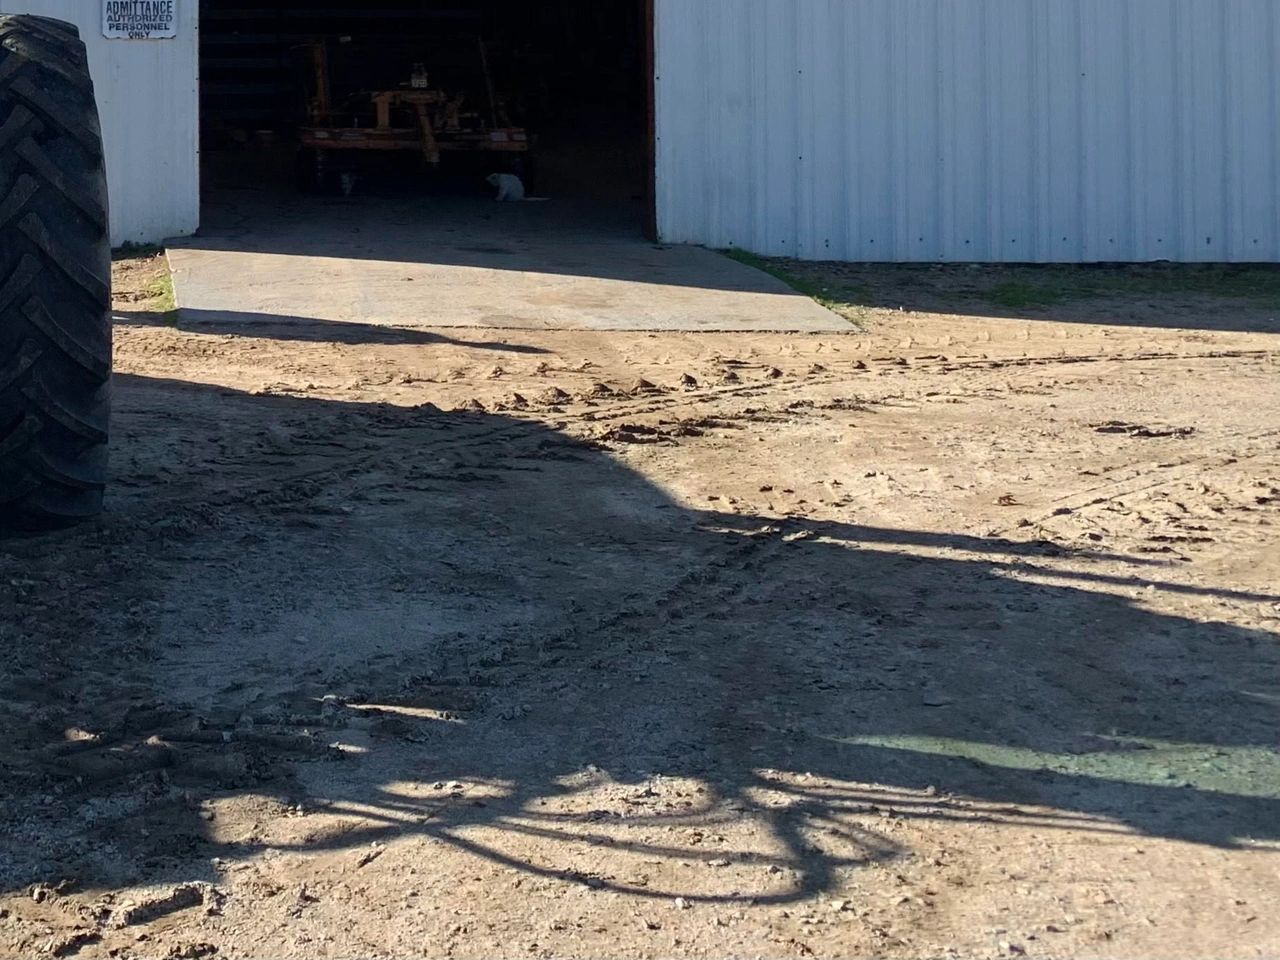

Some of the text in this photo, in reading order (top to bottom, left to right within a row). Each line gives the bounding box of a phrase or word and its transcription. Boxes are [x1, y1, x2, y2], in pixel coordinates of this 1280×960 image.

[106, 0, 173, 16] ADMITTANCE
[107, 14, 173, 23] AUTHORIZED
[108, 22, 170, 31] PERSONNEL
[128, 31, 151, 39] ONLY
